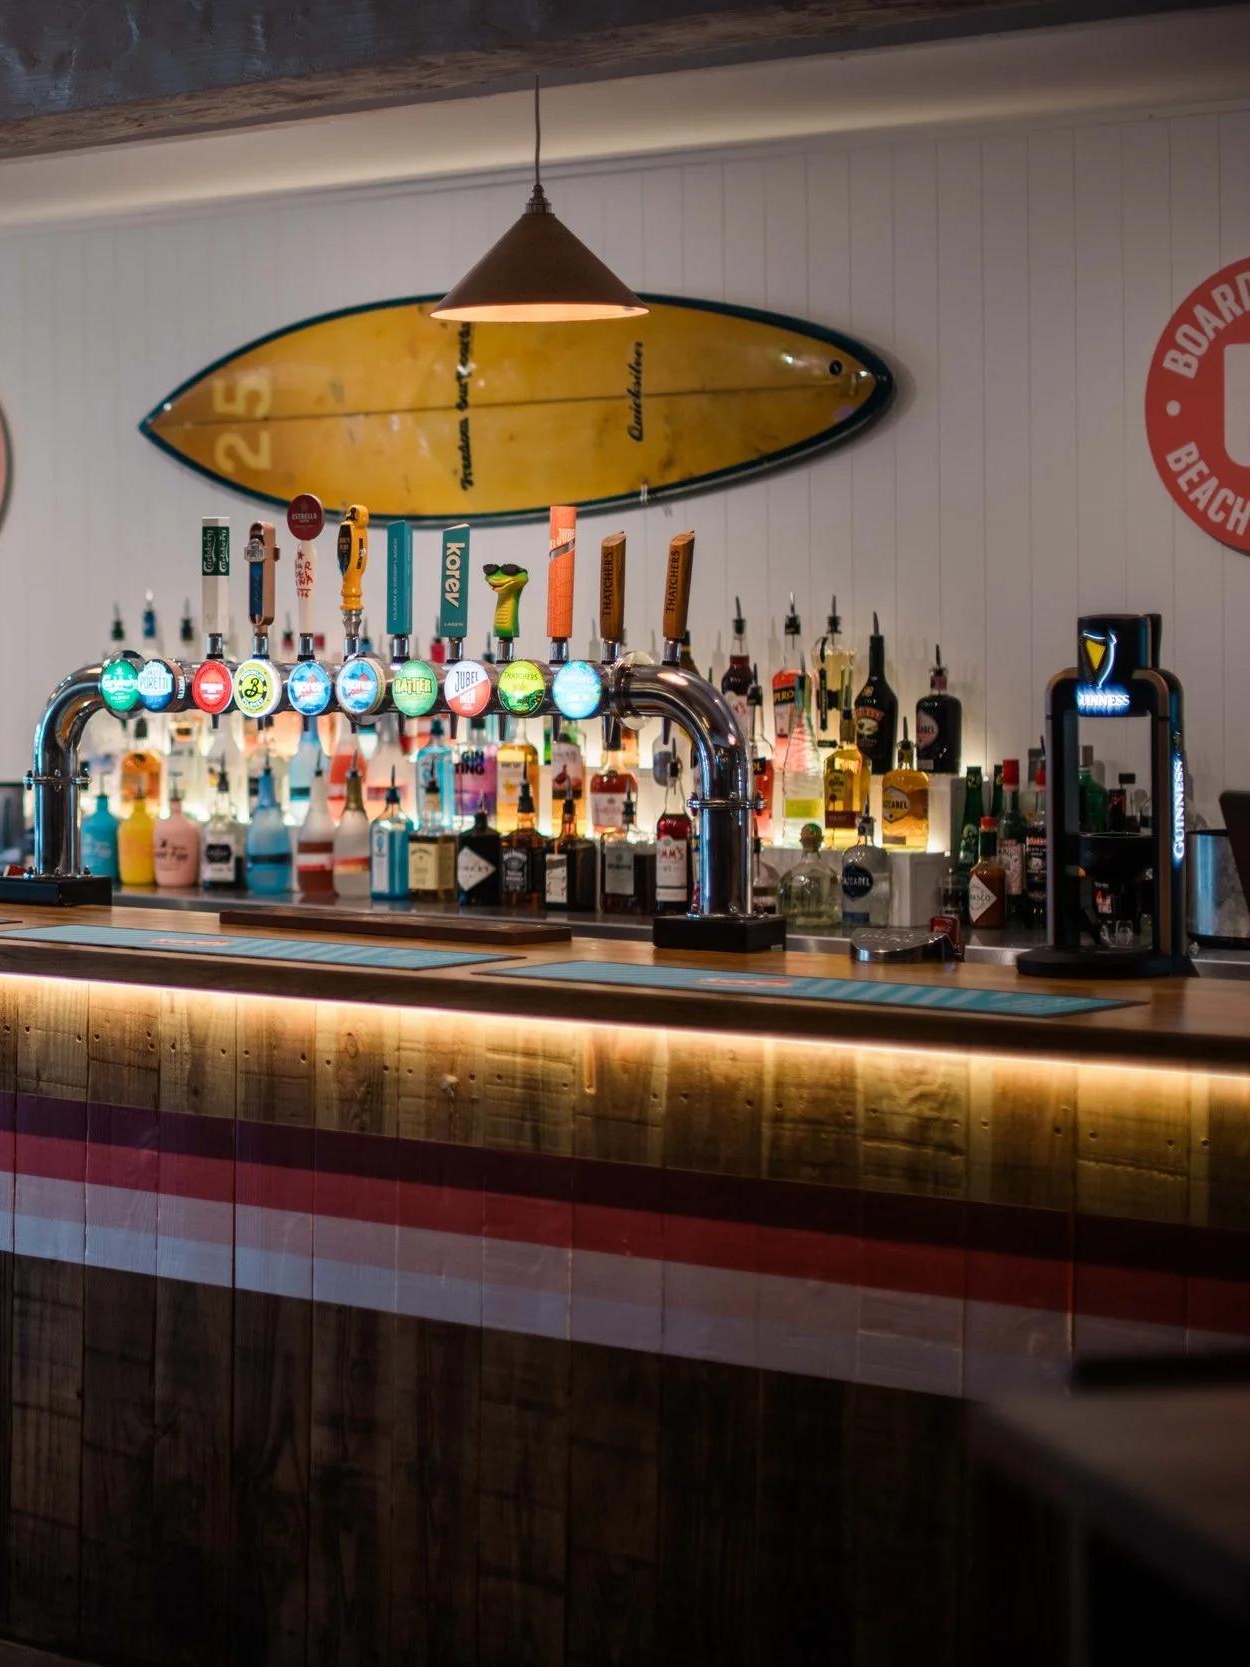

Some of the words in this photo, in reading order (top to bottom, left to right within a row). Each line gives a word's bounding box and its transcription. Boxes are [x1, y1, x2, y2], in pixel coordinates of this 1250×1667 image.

[212, 377, 271, 473] 25
[1166, 441, 1250, 536] BEACH
[292, 512, 317, 520] ESTRELLA
[203, 529, 216, 573] Carlsberg
[219, 529, 229, 573] Carlsberg
[445, 542, 465, 608] korev
[602, 552, 614, 615] THATCHERS
[665, 550, 680, 613] THATCHERS
[140, 677, 168, 689] PORETTI
[395, 677, 432, 695] RATTLER
[455, 671, 478, 692] JUBEL
[504, 672, 538, 680] THATCHERS
[773, 691, 795, 700] PERO
[454, 763, 485, 775] TING
[1173, 760, 1184, 859] GUINNESS
[657, 846, 684, 861] IMM'S
[843, 876, 871, 886] AZCABEL
